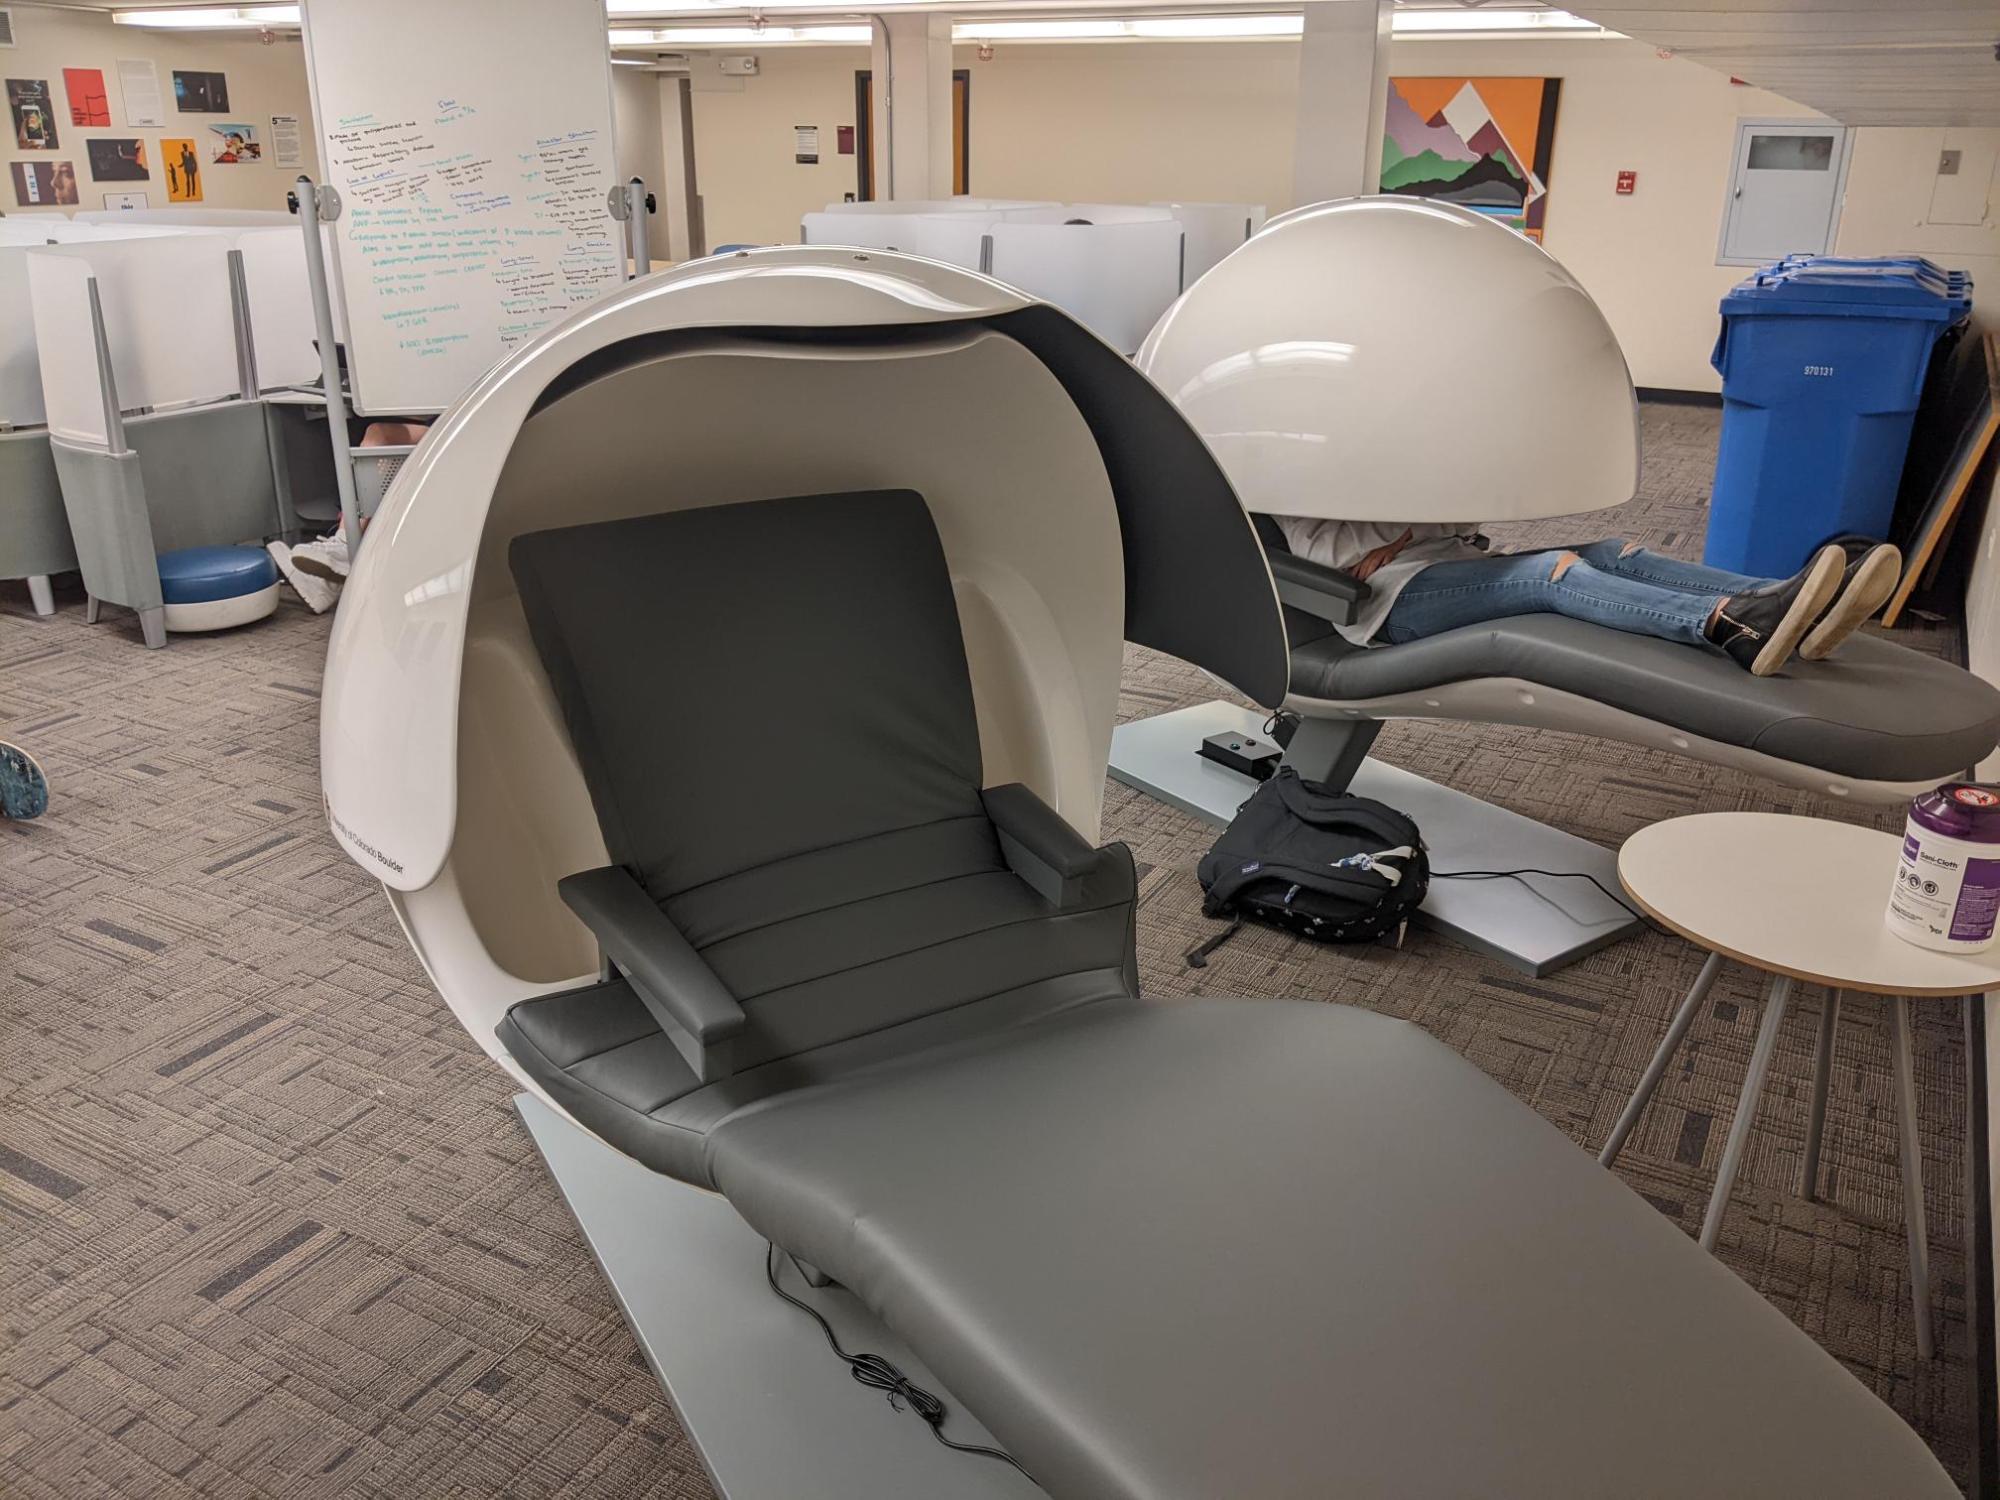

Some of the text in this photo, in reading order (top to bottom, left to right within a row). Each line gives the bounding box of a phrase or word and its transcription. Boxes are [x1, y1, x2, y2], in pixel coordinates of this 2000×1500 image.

[272, 117, 278, 125] 5
[1804, 365, 1834, 376] 970131
[377, 850, 404, 874] Boulder
[1920, 851, 1959, 869] Sani-Cloth
